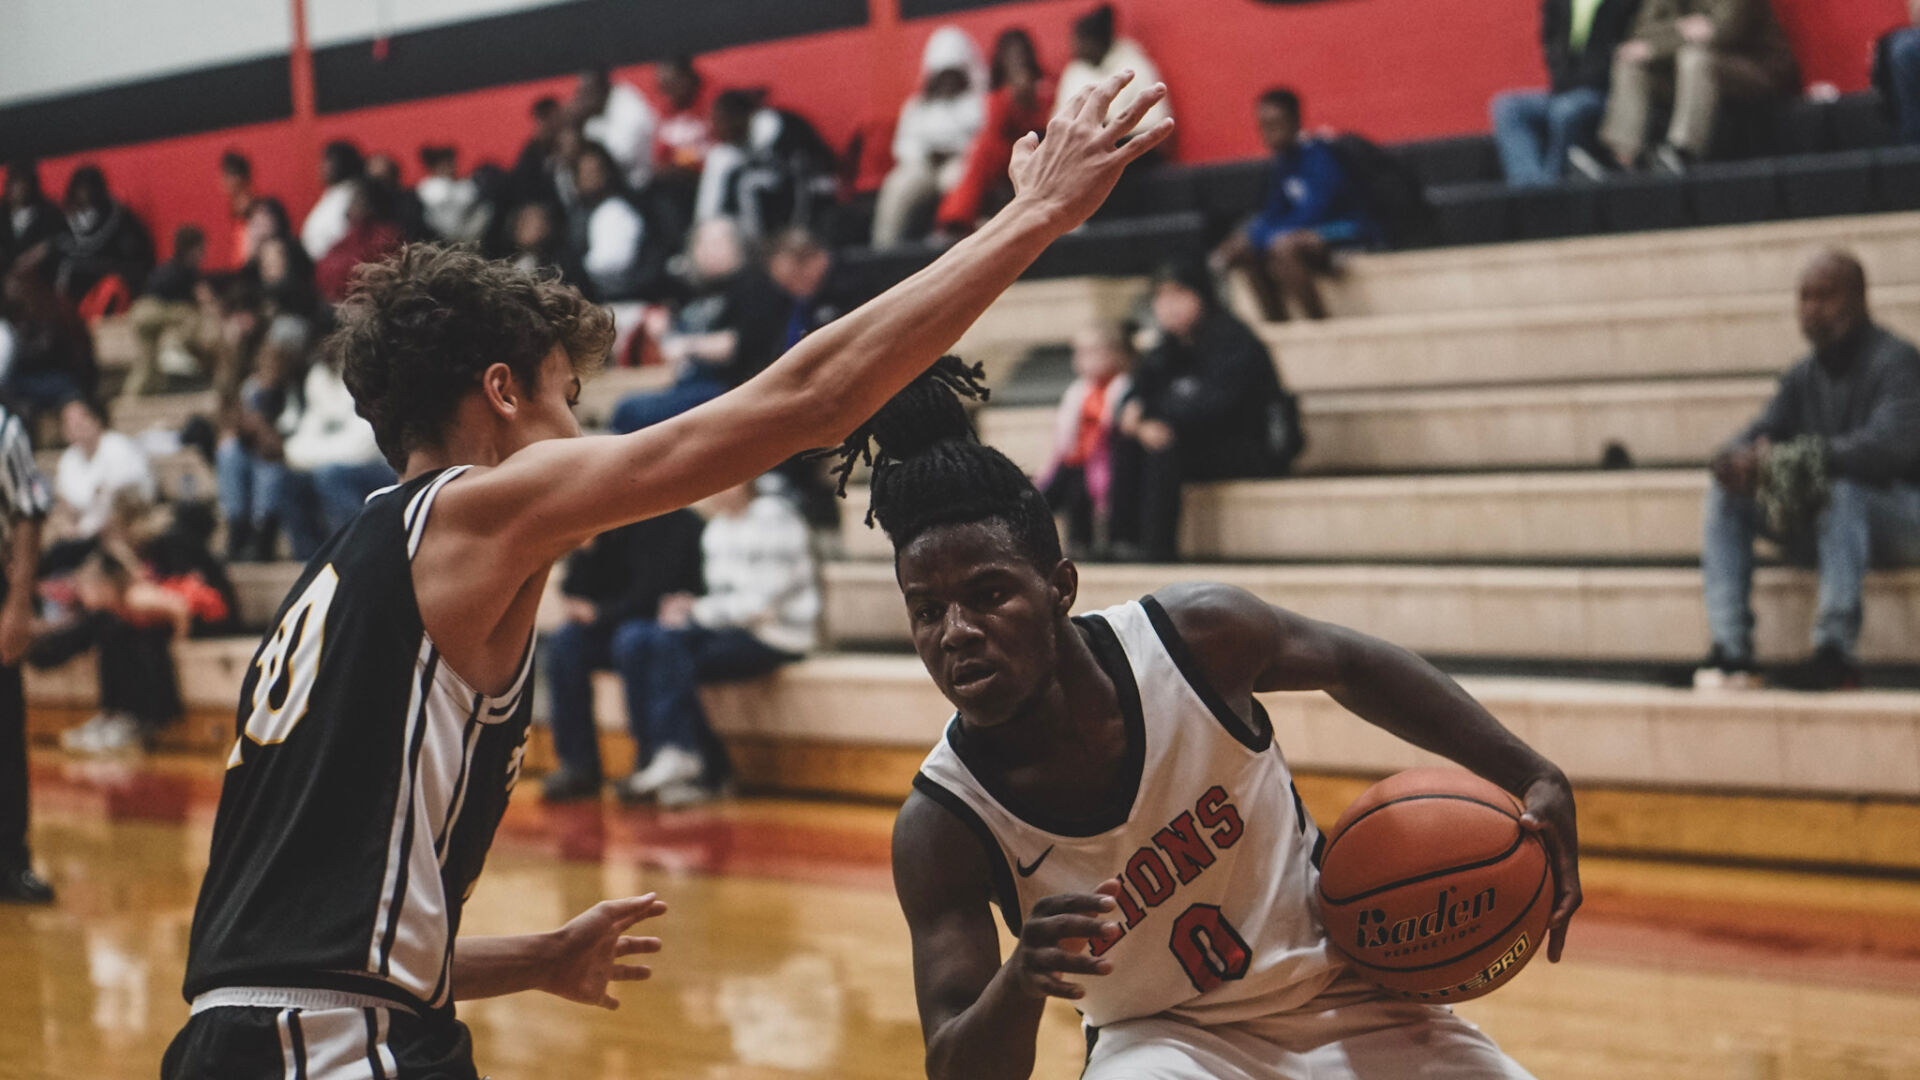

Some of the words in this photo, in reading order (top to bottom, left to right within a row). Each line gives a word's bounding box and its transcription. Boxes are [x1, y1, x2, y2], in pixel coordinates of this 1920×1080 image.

[1168, 902, 1253, 993] 0
[1356, 886, 1497, 949] Baden
[1485, 930, 1531, 981] PRO
